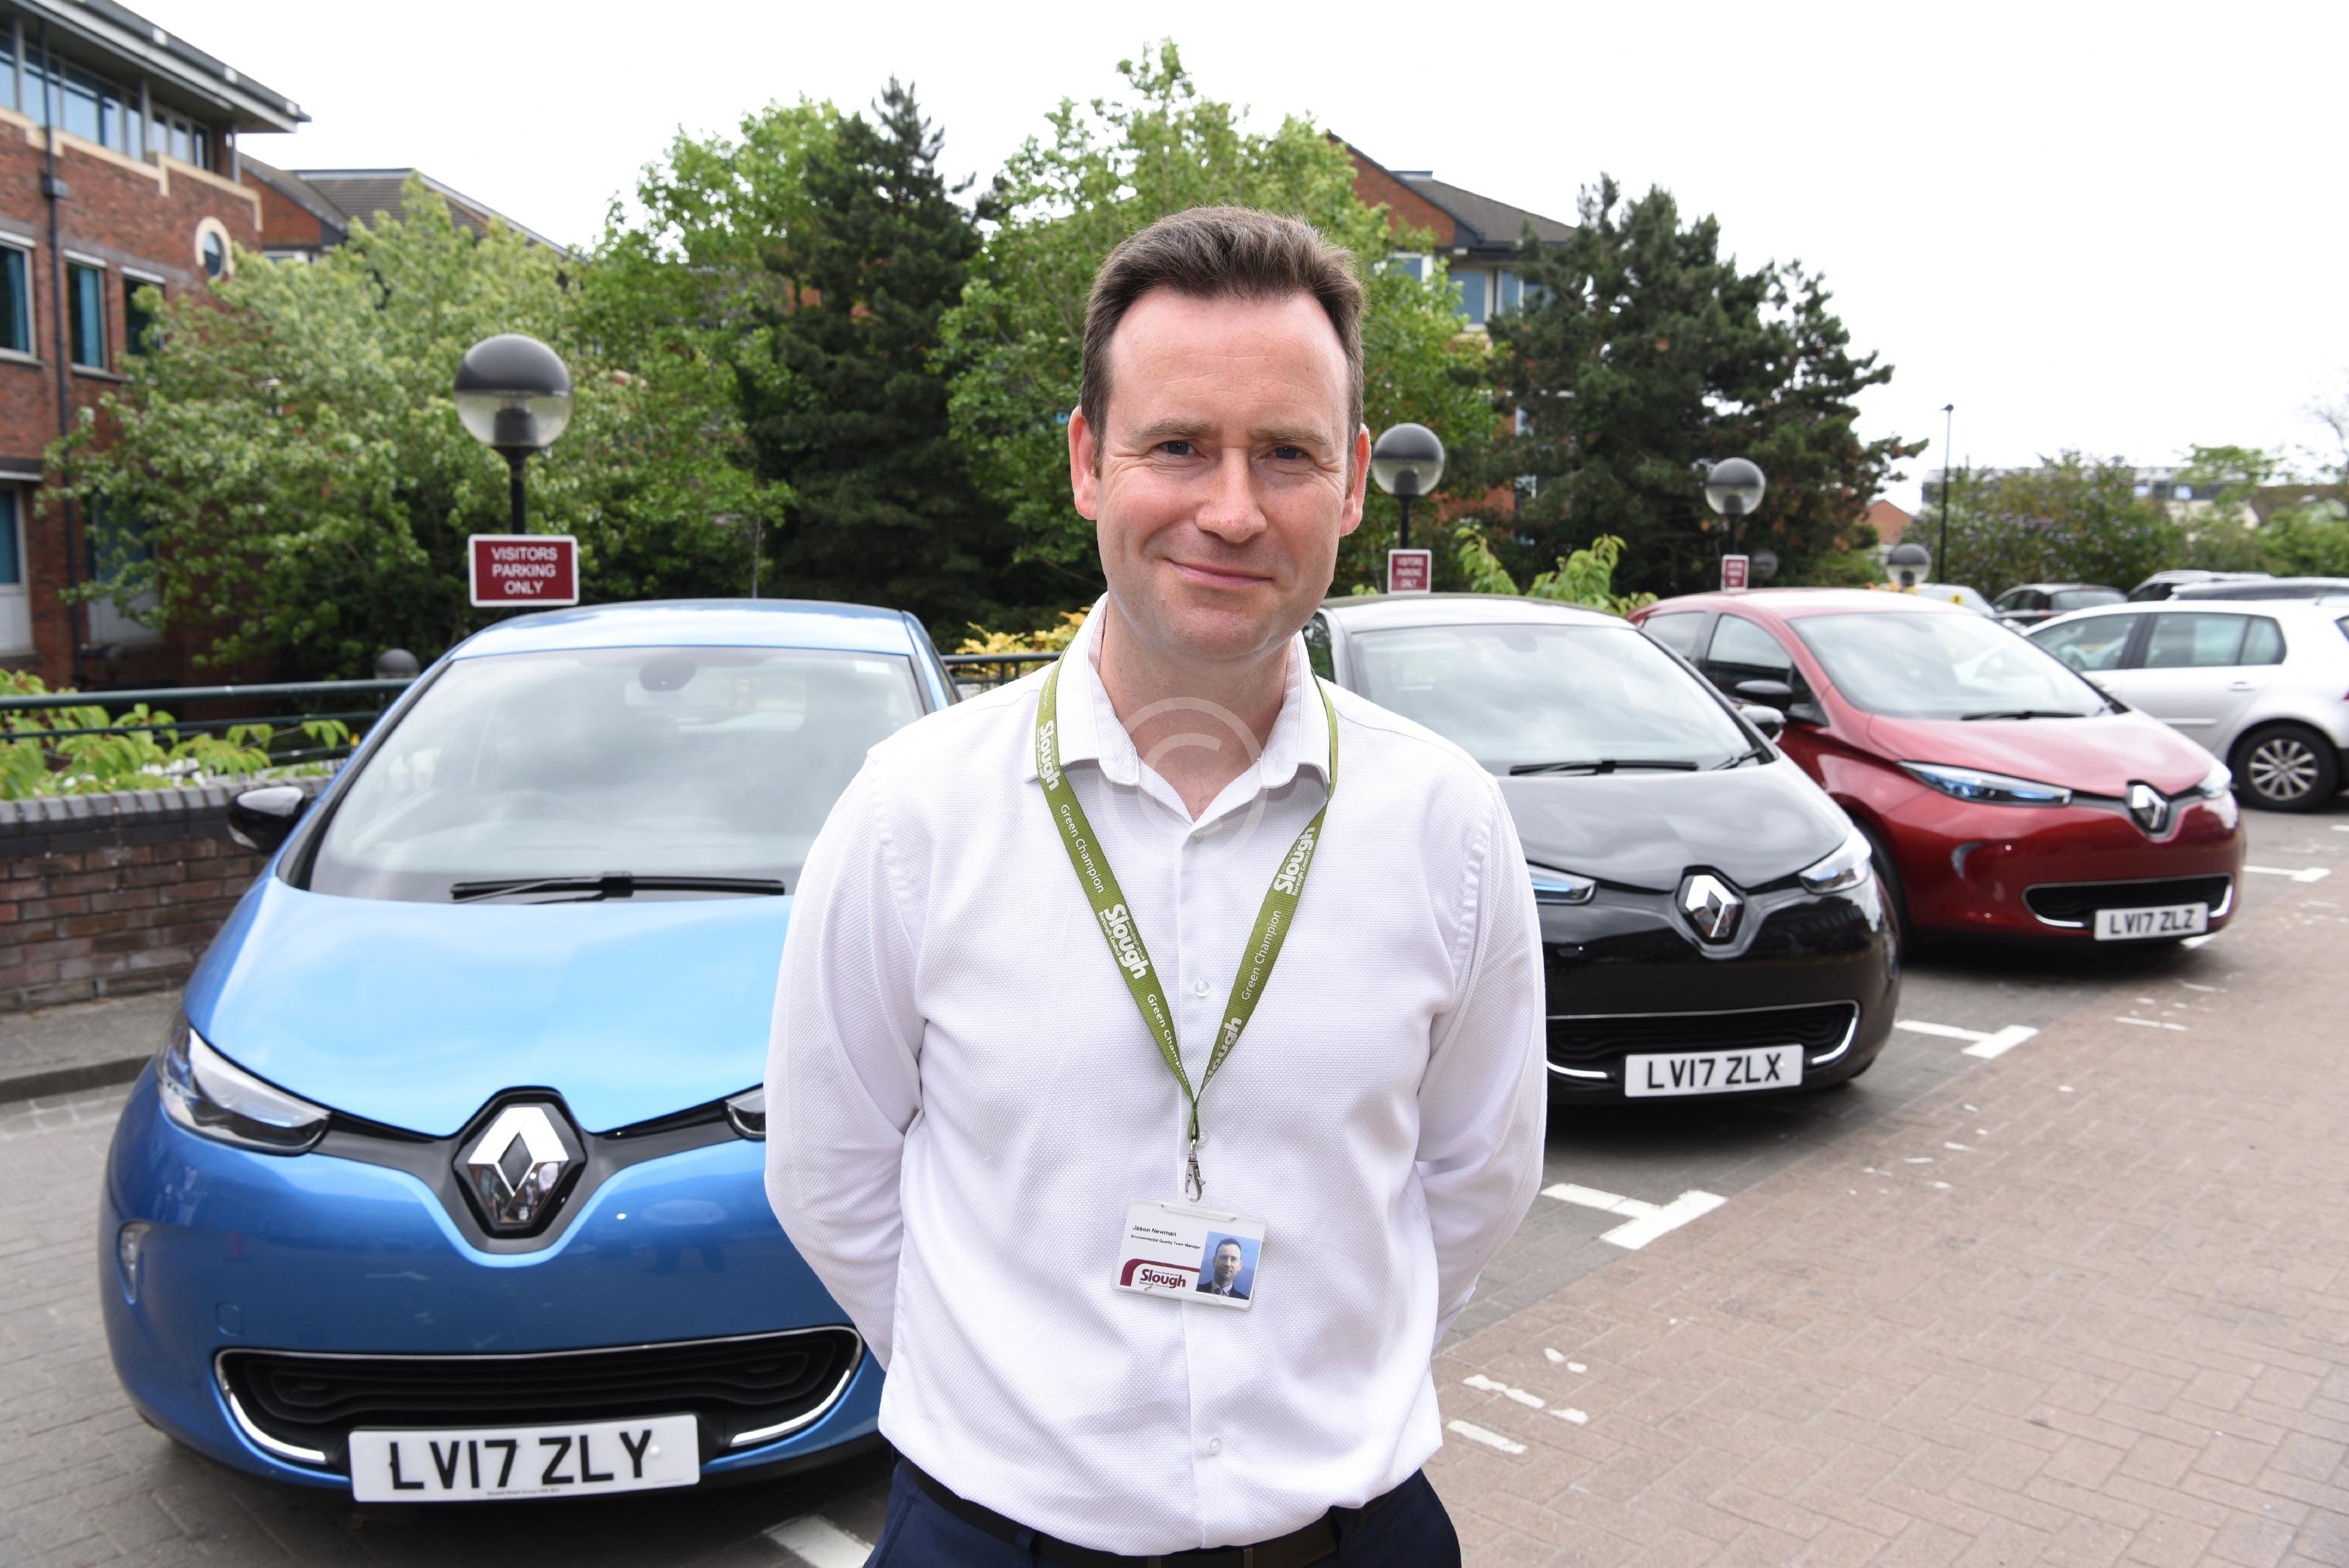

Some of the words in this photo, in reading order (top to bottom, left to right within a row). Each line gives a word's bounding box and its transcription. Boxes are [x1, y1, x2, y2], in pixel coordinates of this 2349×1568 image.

[490, 546, 558, 561] VISITORS
[492, 563, 556, 578] PARKING
[504, 580, 544, 595] ONLY
[1039, 720, 1060, 791] Slough
[1061, 804, 1078, 838] Green
[1075, 838, 1104, 893] Champion
[1274, 827, 1315, 895] Slough
[1292, 872, 1304, 896] Borough
[1300, 852, 1310, 871] Council
[1098, 911, 1112, 936] Borough
[1109, 936, 1122, 957] Council
[2110, 912, 2154, 934] LV17
[2160, 908, 2195, 932] ZLZ
[1104, 904, 1149, 980] Slough
[1241, 968, 1260, 1000] Green
[1255, 910, 1282, 964] Champion
[1147, 993, 1166, 1028] Green
[1647, 1057, 1716, 1089] LV17
[1726, 1053, 1782, 1085] ZLX
[1152, 1228, 1177, 1237] Newman
[1140, 1268, 1186, 1288] Slough
[389, 1437, 518, 1491] LV17
[539, 1429, 653, 1485] ZLY
